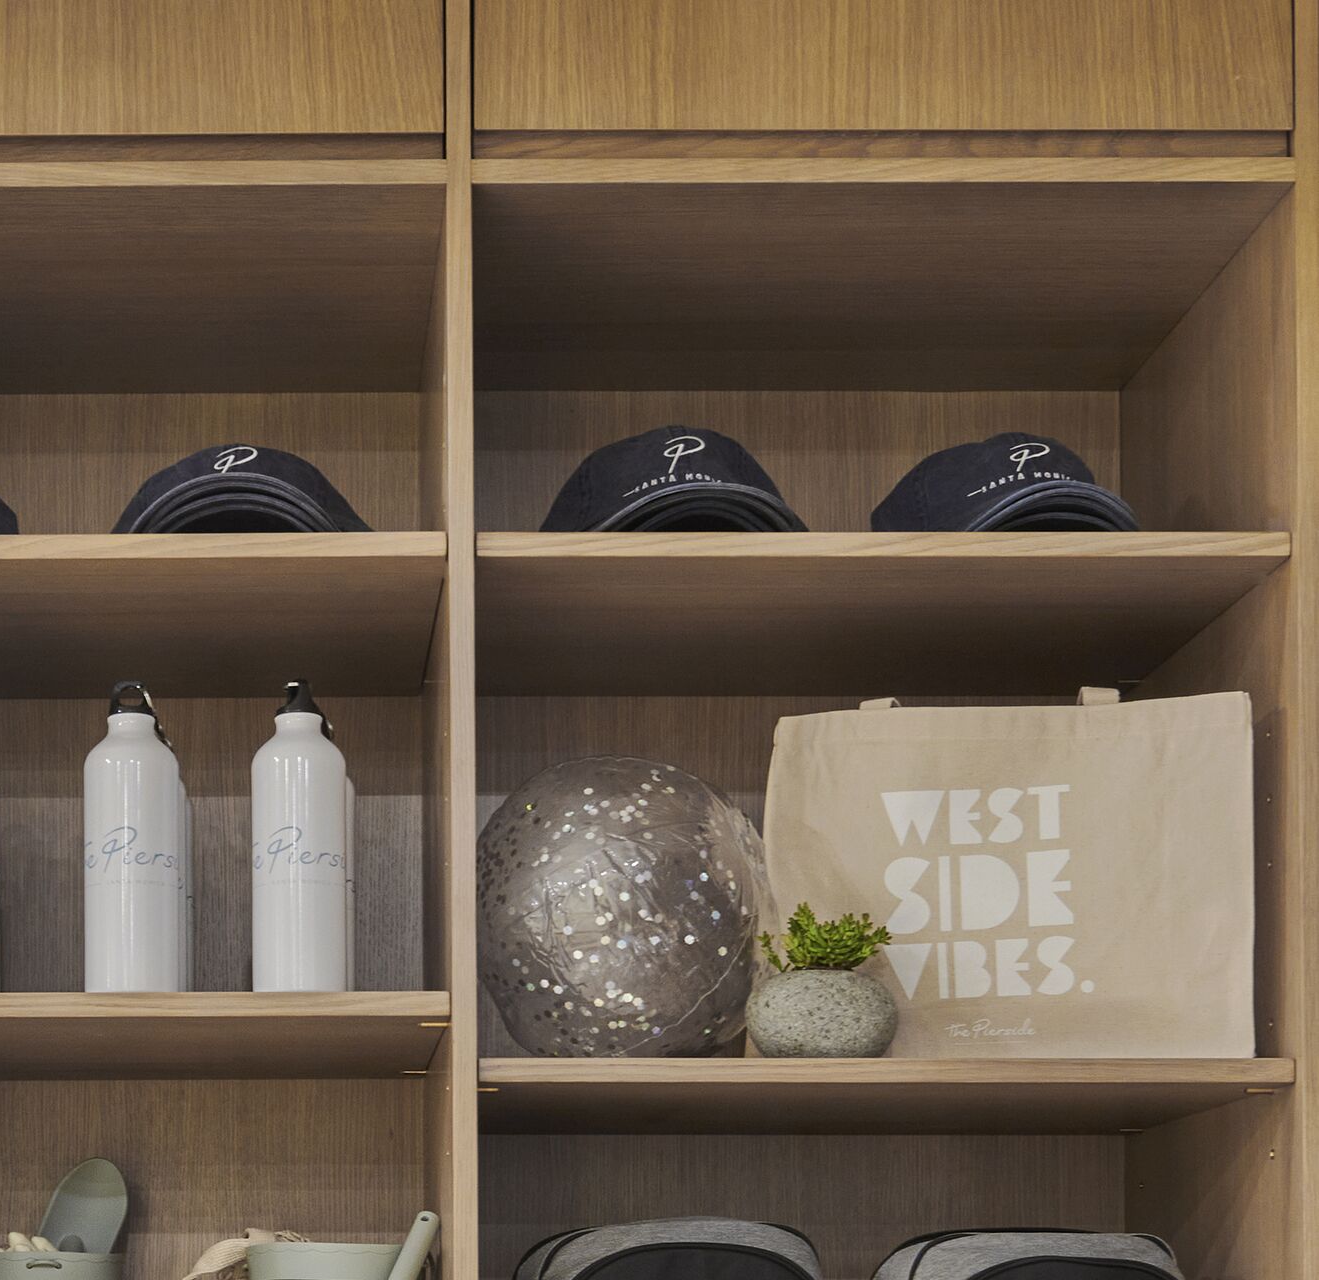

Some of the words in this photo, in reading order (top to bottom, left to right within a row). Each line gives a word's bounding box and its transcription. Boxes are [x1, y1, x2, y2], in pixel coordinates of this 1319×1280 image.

[663, 435, 706, 474] P
[1009, 442, 1051, 472] P
[634, 474, 677, 493] SANTA
[981, 472, 1026, 494] SANTA
[879, 784, 1072, 847] WEST
[883, 849, 1075, 935] SIDE
[883, 935, 1095, 1001] VIBES.
[971, 1017, 1036, 1039] Pierside
